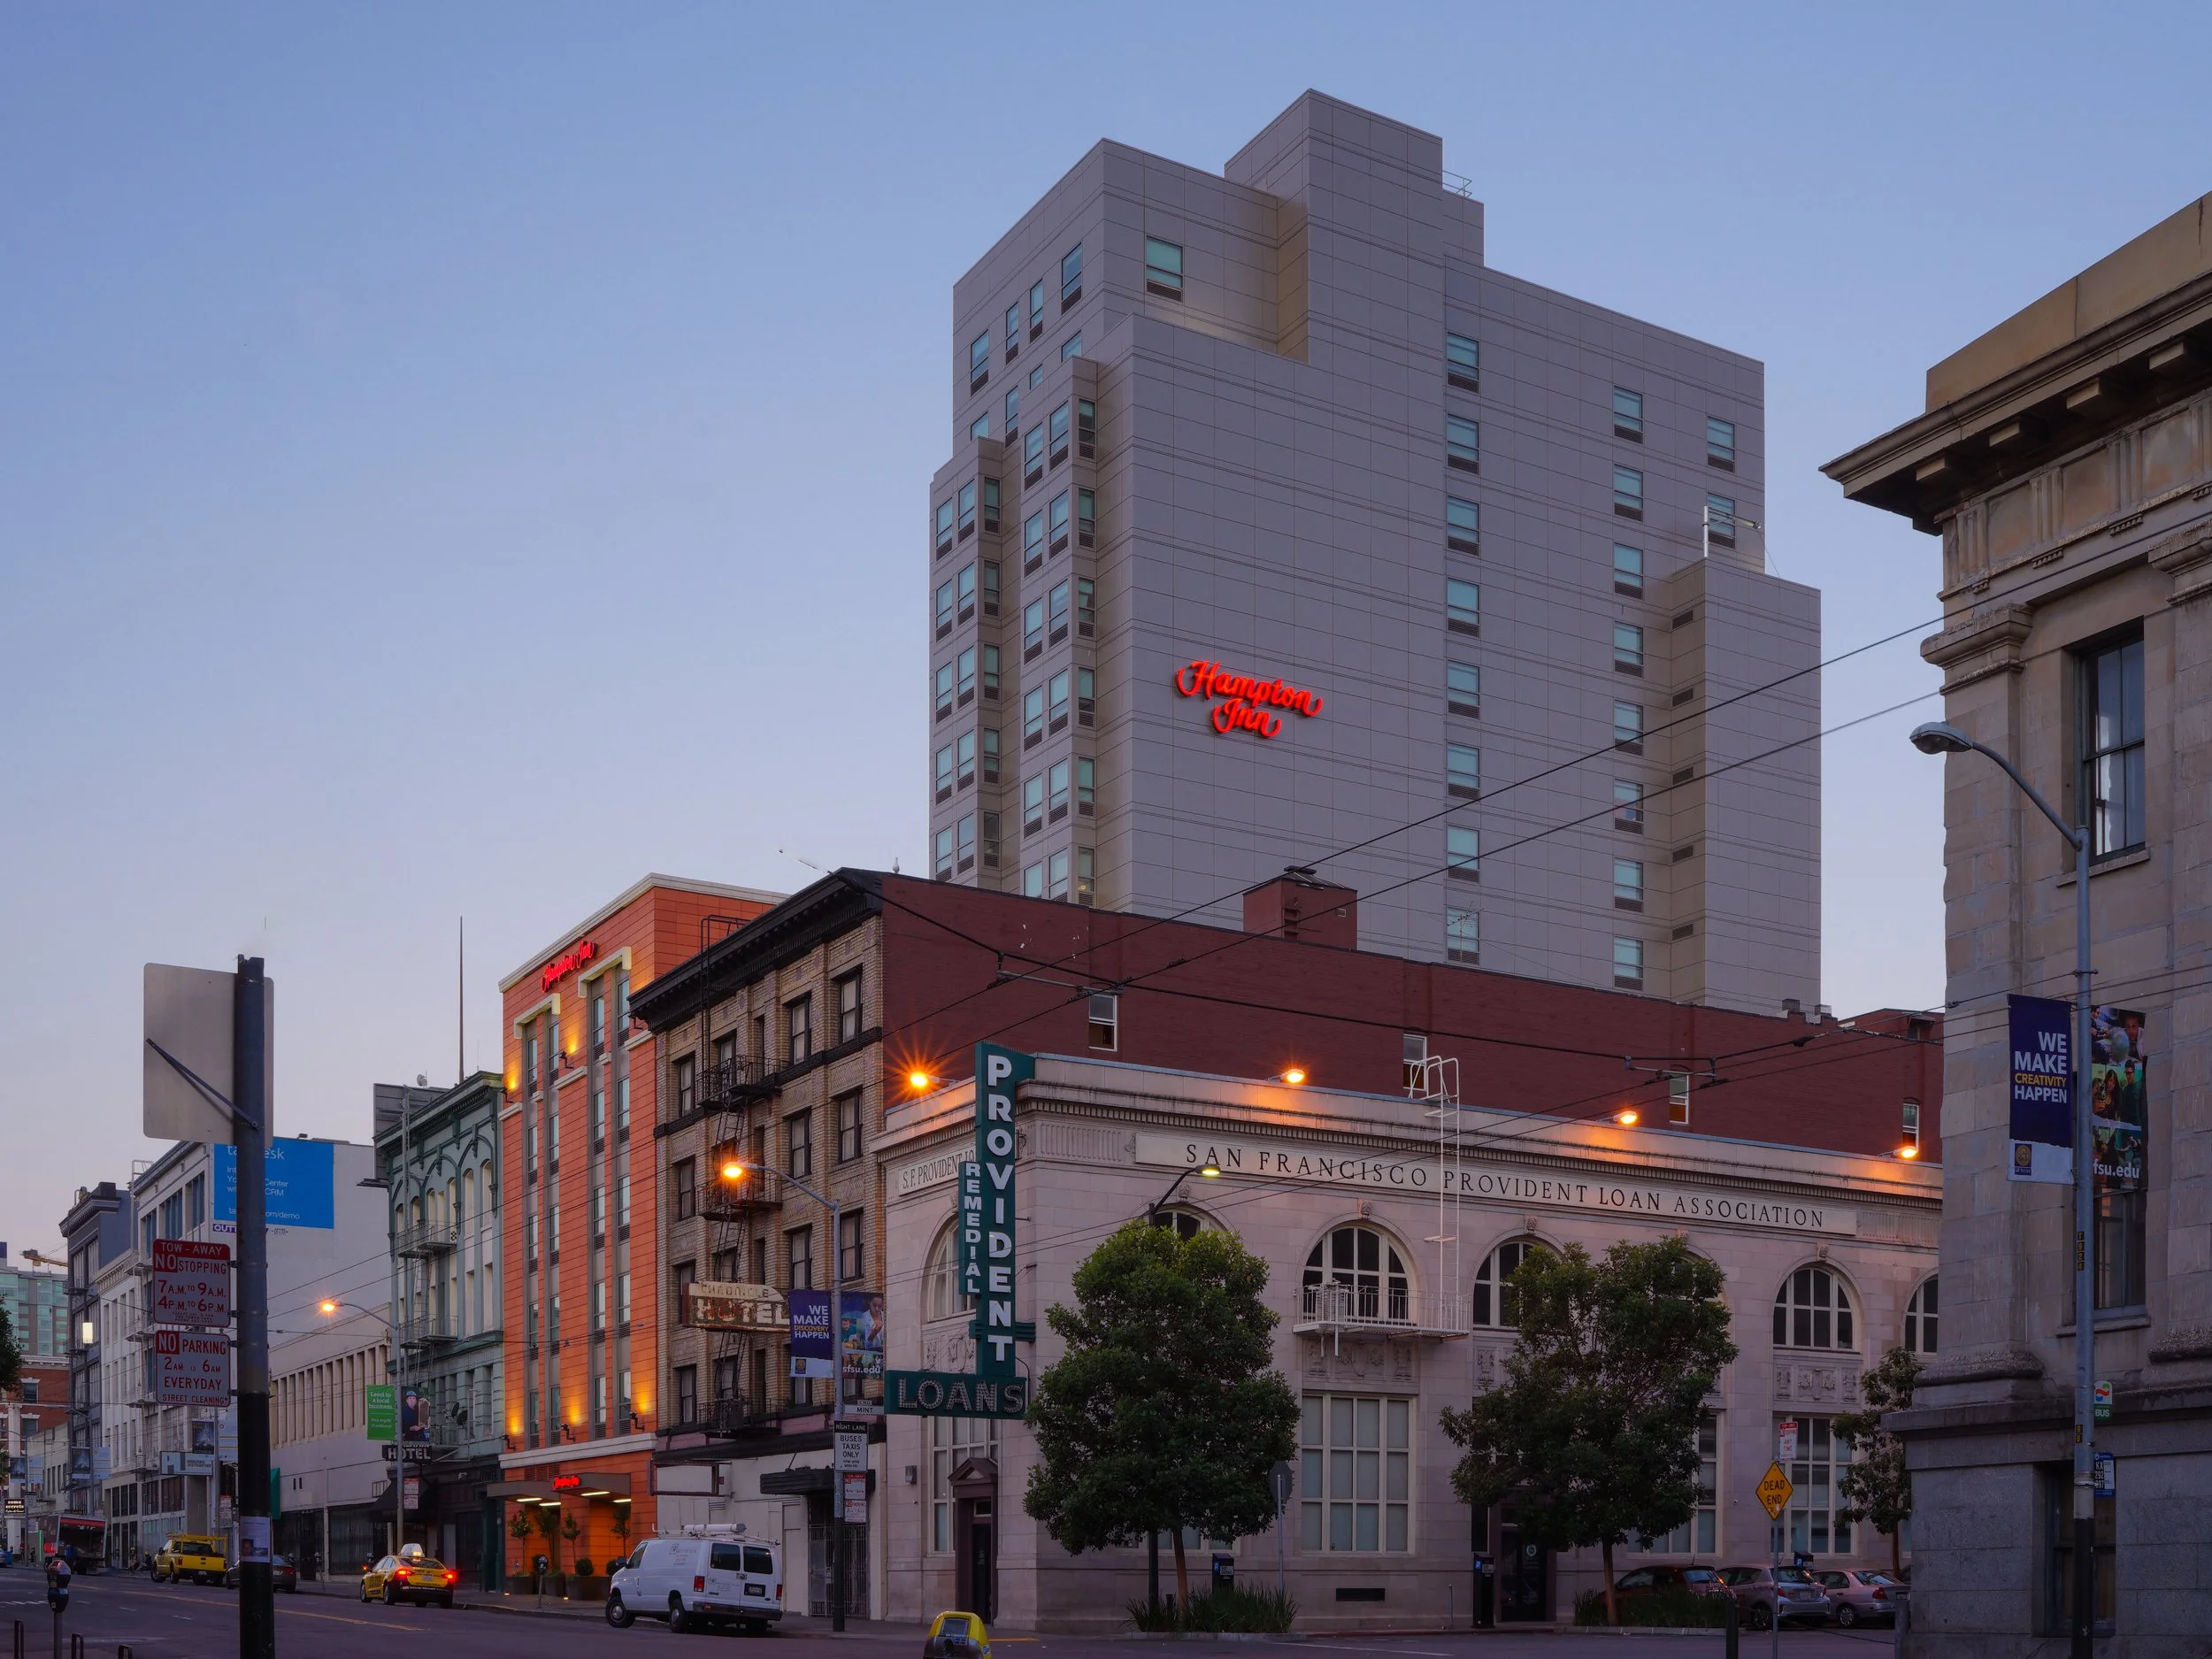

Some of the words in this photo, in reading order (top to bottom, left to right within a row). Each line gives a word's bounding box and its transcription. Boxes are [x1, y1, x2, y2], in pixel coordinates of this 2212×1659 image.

[1176, 661, 1322, 716] Hampton
[1212, 697, 1281, 737] Inn
[2038, 1031, 2067, 1053] WE
[2014, 1050, 2067, 1074] MAKE
[2015, 1072, 2067, 1087] CREATIVITY
[2014, 1085, 2067, 1104] HAPPEN
[918, 1153, 963, 1185] PROVIDENT
[2093, 1158, 2139, 1179] fsu.edu
[1185, 1144, 1242, 1167] SAN
[1258, 1151, 1427, 1186] FRANCISCO
[1443, 1171, 1588, 1203] PROVIDENT
[1599, 1187, 1661, 1211] LOAN
[1674, 1196, 1824, 1227] ASSOCIATION
[985, 1054, 1015, 1363] PROVIDENT
[964, 1162, 982, 1294] REMEDIAL
[160, 1241, 182, 1253] TOW
[192, 1244, 222, 1256] AWAY
[155, 1253, 177, 1270] NO
[178, 1260, 227, 1274] STOPPING
[696, 1299, 790, 1325] HOTEL
[793, 1315, 829, 1325] MAKE
[808, 1304, 829, 1315] WE
[158, 1333, 177, 1352] NO
[182, 1339, 227, 1355] PARKING
[794, 1331, 830, 1340] HAPPEN
[842, 1363, 880, 1374] sfsu.edu
[164, 1376, 222, 1391] EVERYDAY
[162, 1394, 188, 1402] STREET
[191, 1394, 225, 1404] CLEANING
[897, 1377, 1024, 1413] LOANS
[2094, 1409, 2110, 1417] BUS
[1763, 1479, 1786, 1491] DEAD
[1766, 1494, 1782, 1505] END
